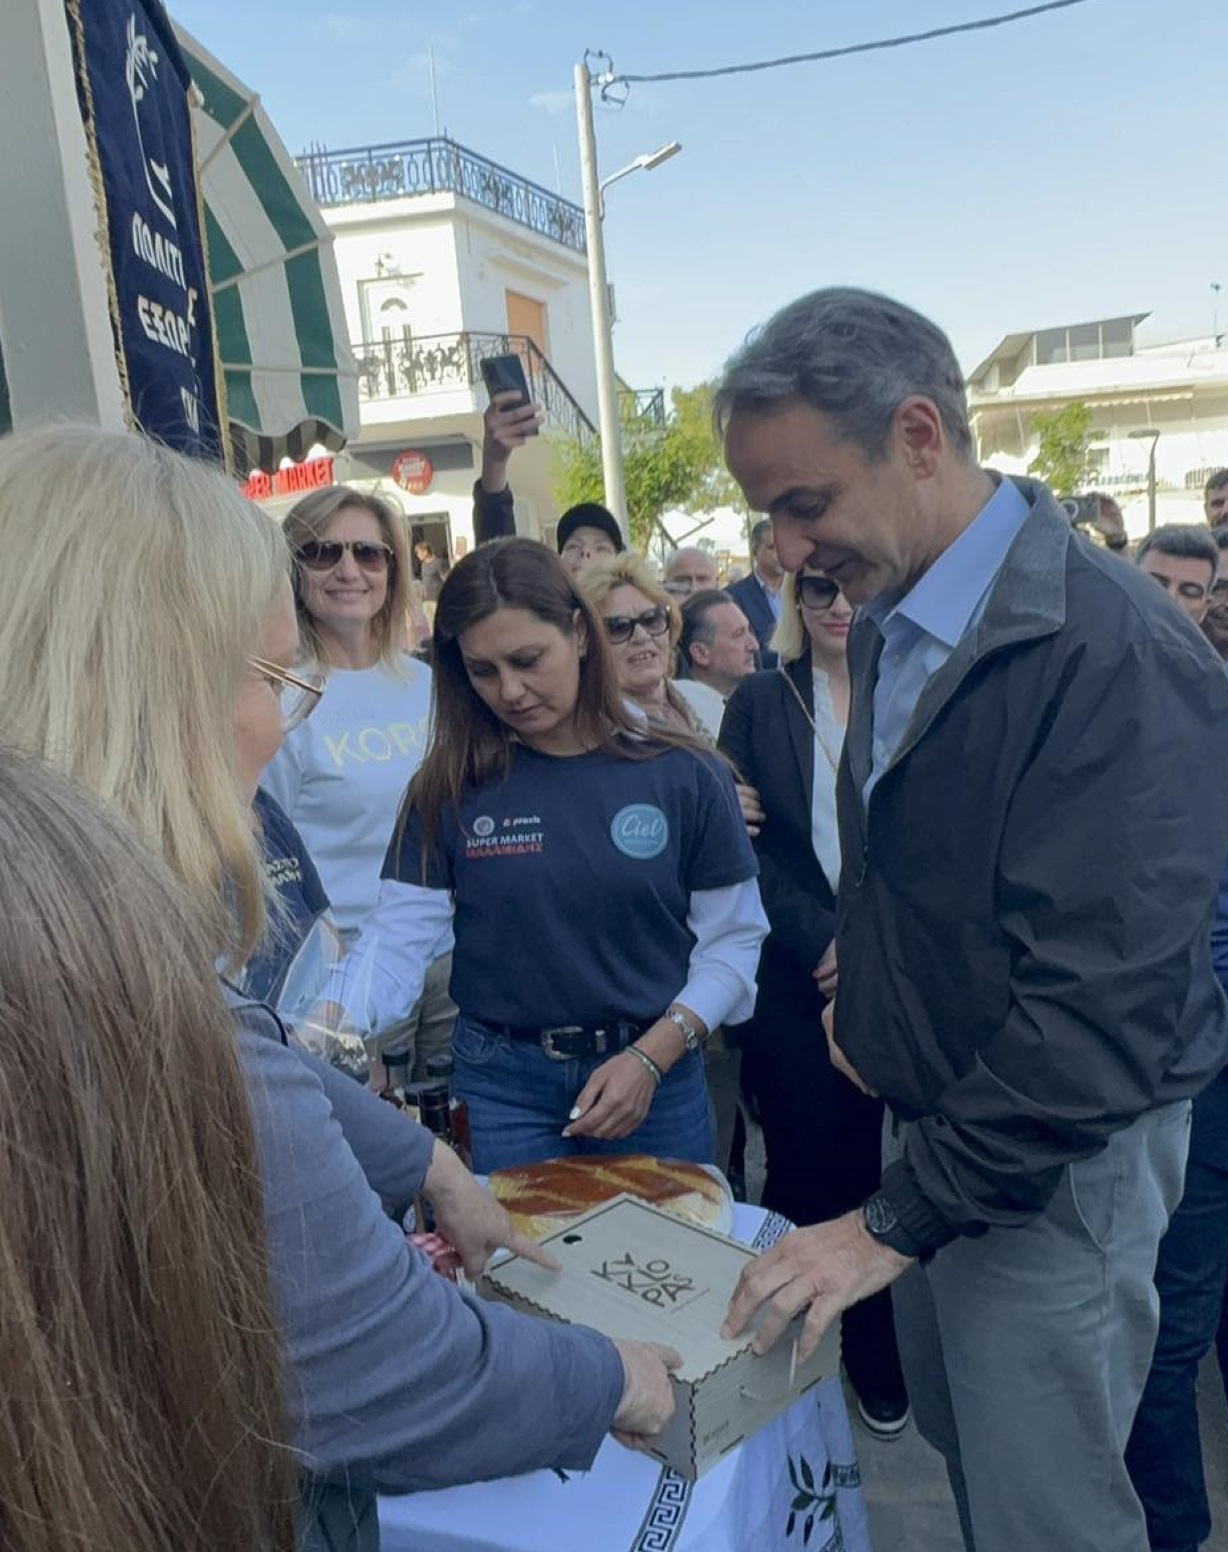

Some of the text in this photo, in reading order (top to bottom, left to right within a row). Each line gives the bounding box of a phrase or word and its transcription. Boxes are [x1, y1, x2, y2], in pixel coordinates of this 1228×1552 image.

[276, 457, 334, 496] MARKET
[620, 813, 663, 838] Ciel
[466, 832, 544, 848] SUPER MARKET
